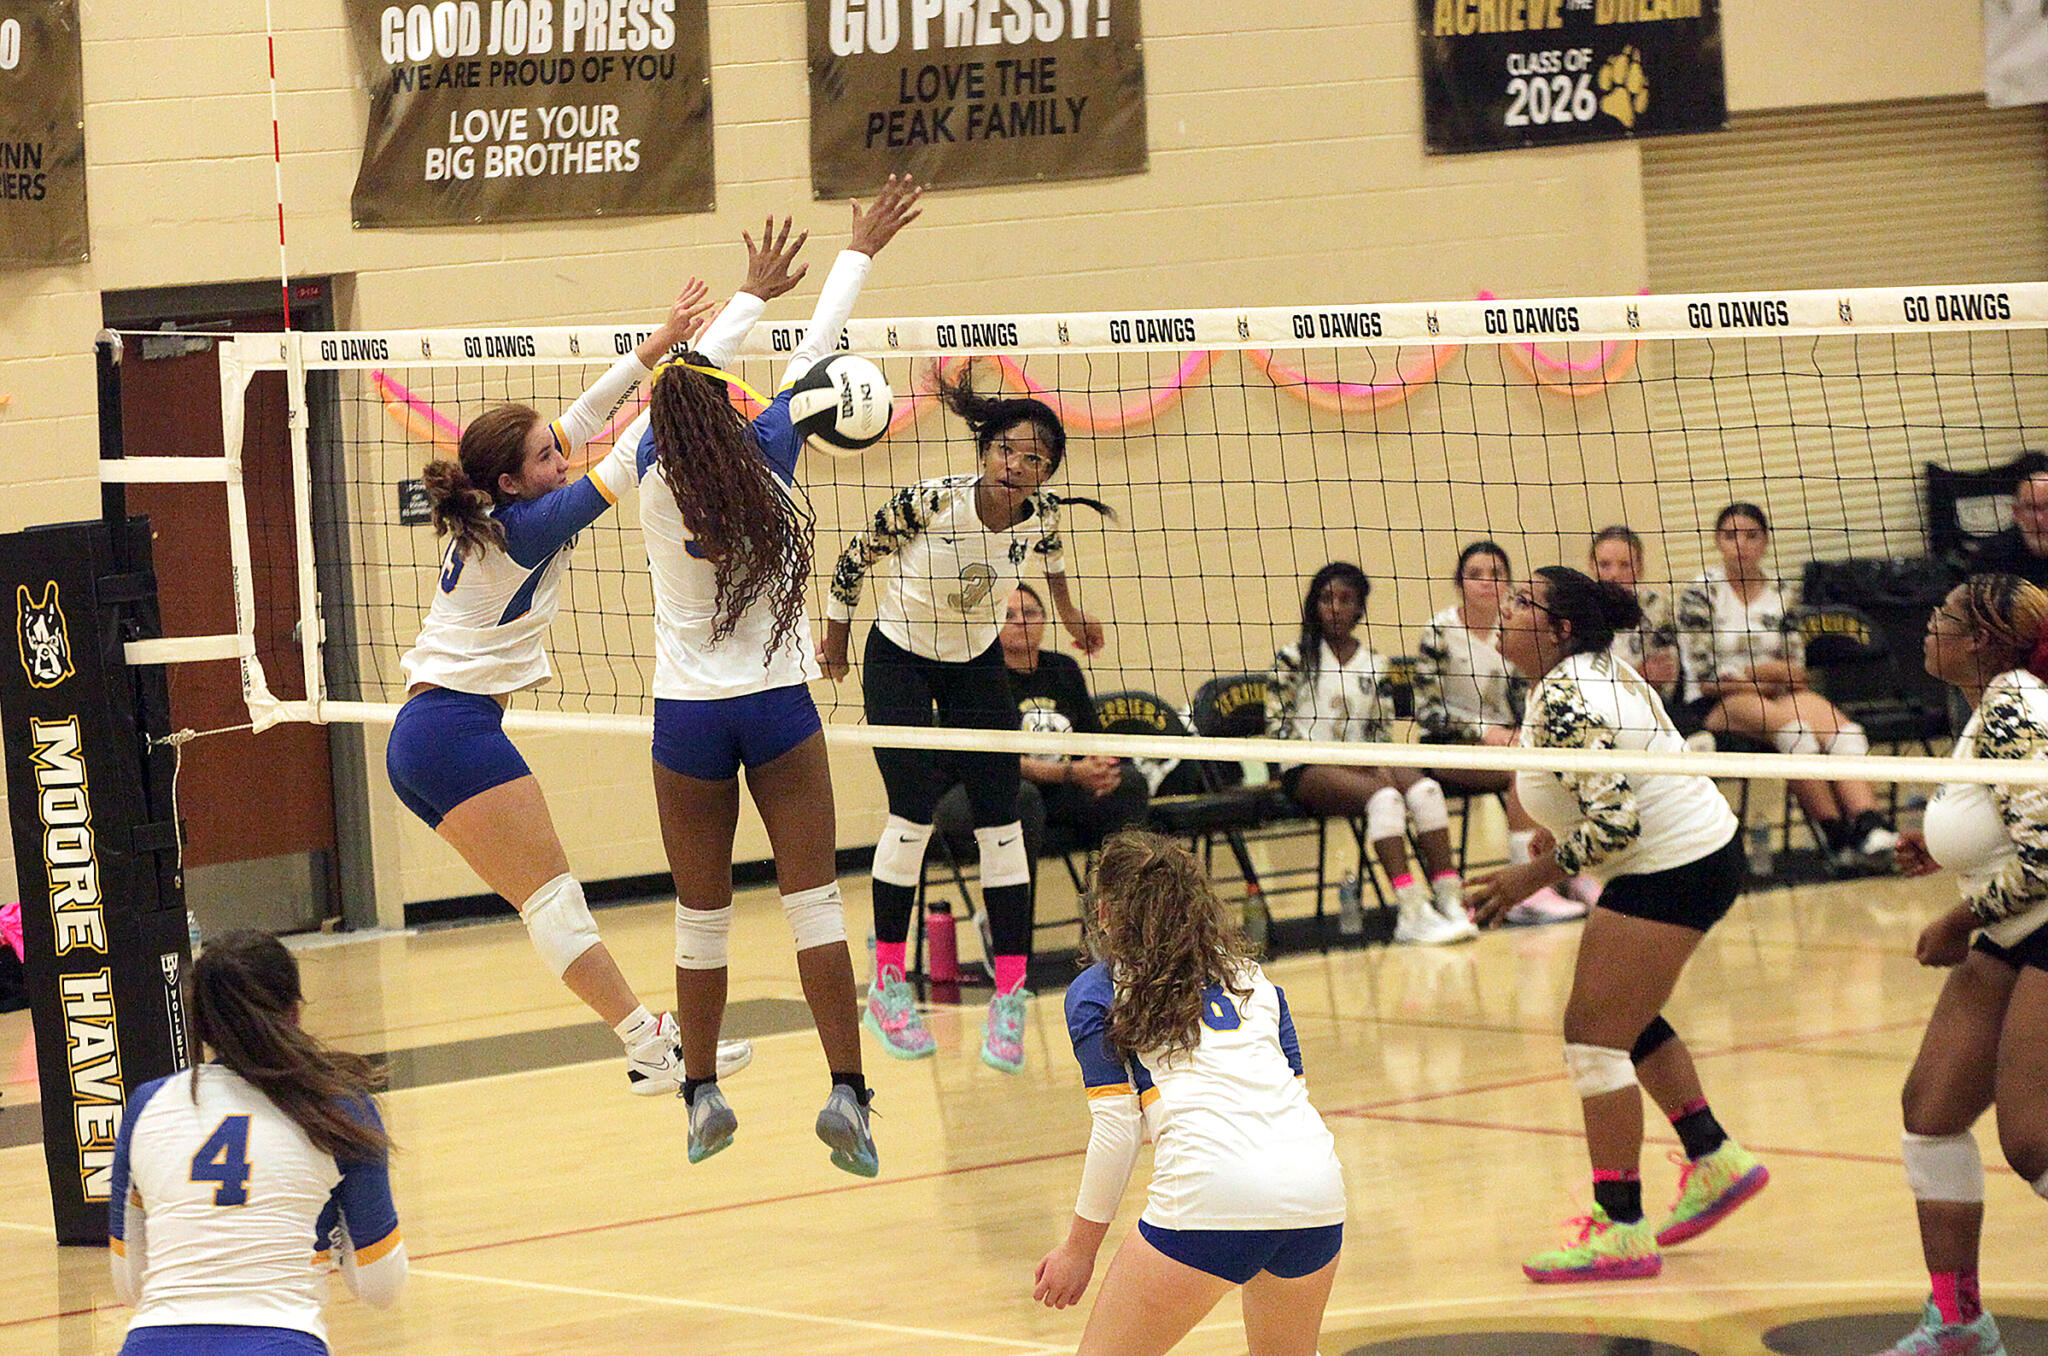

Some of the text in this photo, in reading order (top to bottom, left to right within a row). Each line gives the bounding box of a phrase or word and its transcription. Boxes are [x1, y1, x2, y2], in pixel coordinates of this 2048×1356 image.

[381, 0, 676, 64] GOOD JOB PRESS
[829, 0, 901, 57] GO
[1433, 0, 1564, 37] ACHIEVE
[391, 53, 677, 94] WE ARE PROUD OF YOU
[1506, 48, 1594, 76] CLASS OF
[901, 57, 1056, 104] LOVE THE
[1504, 74, 1598, 127] 2026
[449, 104, 620, 144] LOVE YOUR
[866, 96, 1089, 148] PEAK FAMILY
[0, 142, 43, 170] NN
[424, 138, 642, 181] BIG BROTHERS
[0, 173, 47, 201] IERS
[1484, 306, 1580, 335] GO DAWGS
[1687, 301, 1790, 328] GO DAWGS
[1904, 293, 2012, 323] GO DAWGS
[772, 329, 792, 351] GO
[937, 323, 1019, 348] GO DAWGS
[1110, 318, 1197, 344] GO DAWGS
[1292, 312, 1383, 339] GO DAWGS
[321, 339, 389, 361] GO DAWGS
[464, 335, 536, 358] GO DAWGS
[614, 333, 632, 355] GO
[29, 715, 127, 1203] MOORE HAVEN
[188, 1113, 253, 1208] 4
